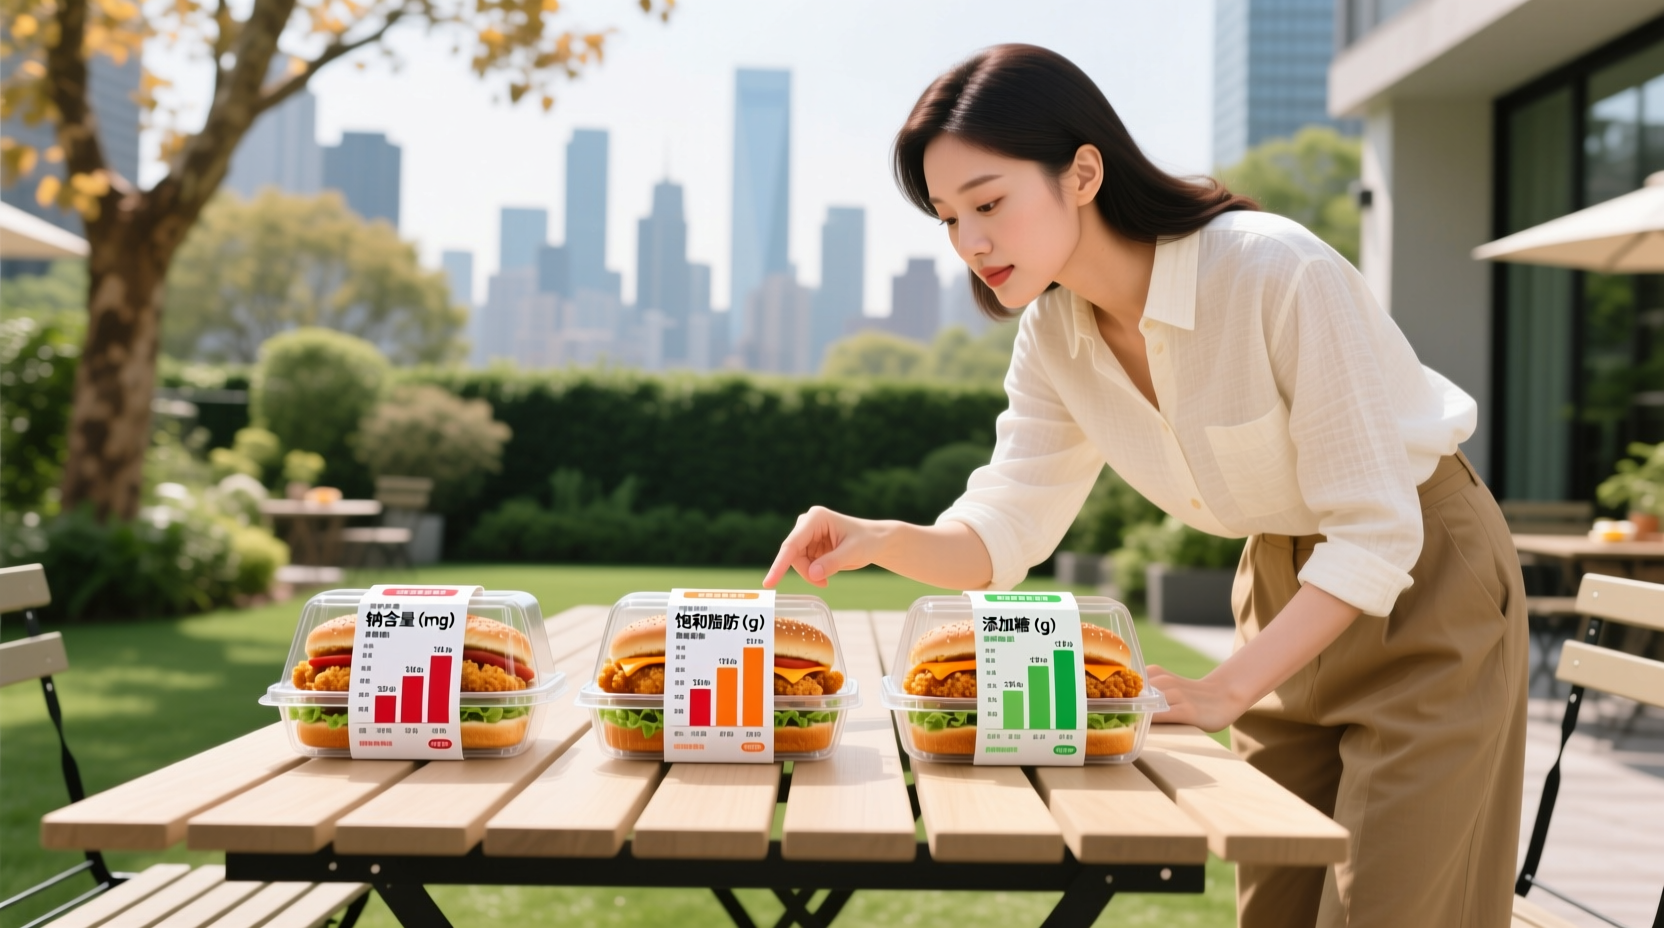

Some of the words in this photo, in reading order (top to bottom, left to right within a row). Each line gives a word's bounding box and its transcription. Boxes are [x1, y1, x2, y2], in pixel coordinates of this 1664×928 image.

[419, 612, 455, 630] (mg)
[743, 614, 765, 632] (g)
[1034, 618, 1055, 635] (g)
